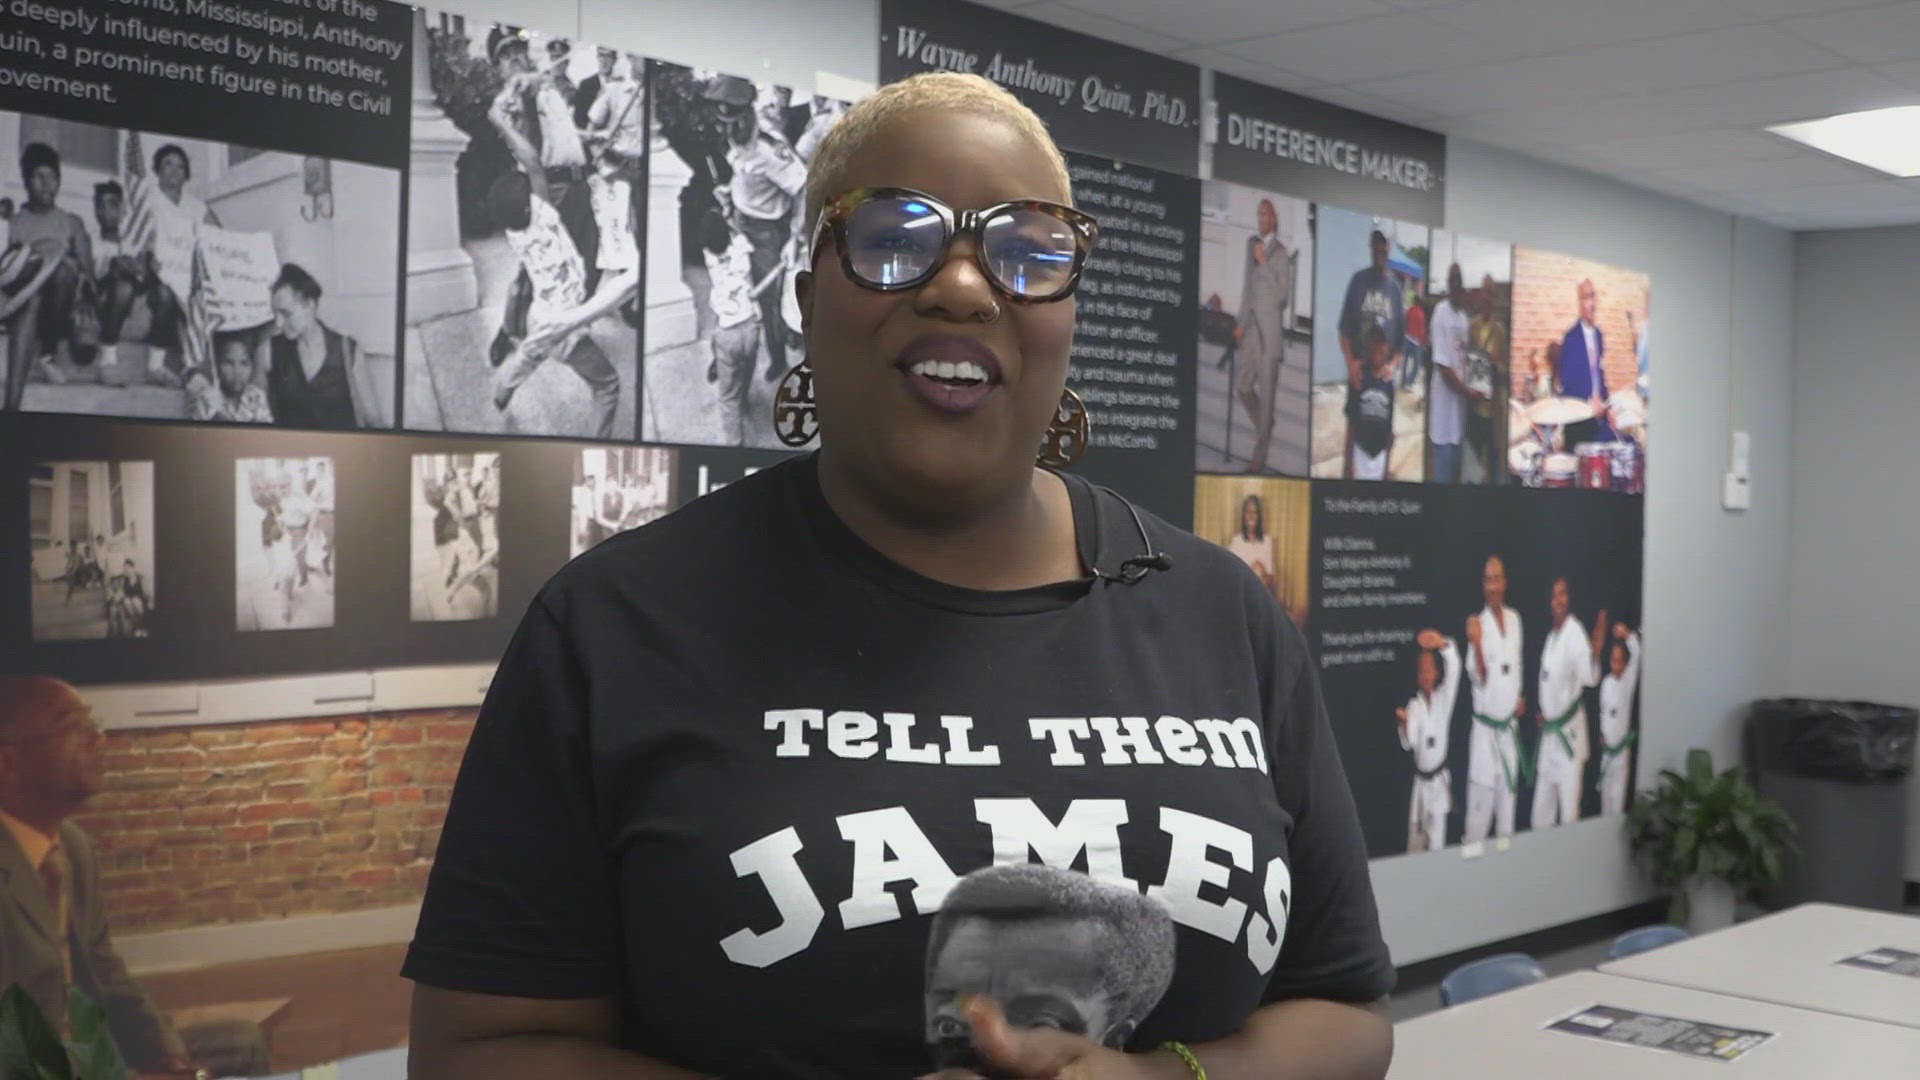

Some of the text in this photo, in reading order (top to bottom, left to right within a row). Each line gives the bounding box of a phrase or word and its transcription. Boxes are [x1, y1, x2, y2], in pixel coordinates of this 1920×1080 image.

[186, 0, 404, 60] Mississippi, Anthony
[10, 0, 99, 35] deeply
[104, 13, 230, 55] influenced
[236, 37, 263, 65] by
[268, 43, 299, 68] his
[304, 54, 389, 87] mother,
[52, 42, 67, 60] a
[75, 46, 204, 84] prominent
[210, 64, 277, 97] figure
[281, 79, 302, 101] in
[308, 84, 344, 108] the
[347, 90, 392, 116] Civil
[896, 26, 1190, 128] Wayne Anthony Quin, PhD.
[1227, 112, 1430, 191] DIFFERENCE MAKER
[1111, 173, 1154, 193] national
[1111, 194, 1121, 207] at
[1131, 200, 1166, 219] young
[1110, 237, 1130, 252] the
[1152, 226, 1184, 245] voting
[1122, 261, 1153, 281] clung
[1154, 267, 1165, 280] to
[1166, 269, 1183, 283] his
[1100, 282, 1113, 295] as
[1115, 282, 1167, 302] instructed
[1096, 302, 1116, 317] the
[1116, 303, 1139, 319] face
[1139, 306, 1153, 321] of
[1081, 321, 1108, 337] from
[1110, 327, 1123, 339] an
[1115, 350, 1124, 361] a
[1125, 351, 1153, 365] great
[1154, 352, 1178, 367] deal
[1083, 366, 1105, 381] and
[1105, 367, 1145, 384] trauma
[1118, 391, 1161, 407] became
[1161, 395, 1180, 409] the
[1111, 413, 1158, 430] integrate
[1158, 416, 1178, 430] the
[720, 798, 1291, 975] JAMES
